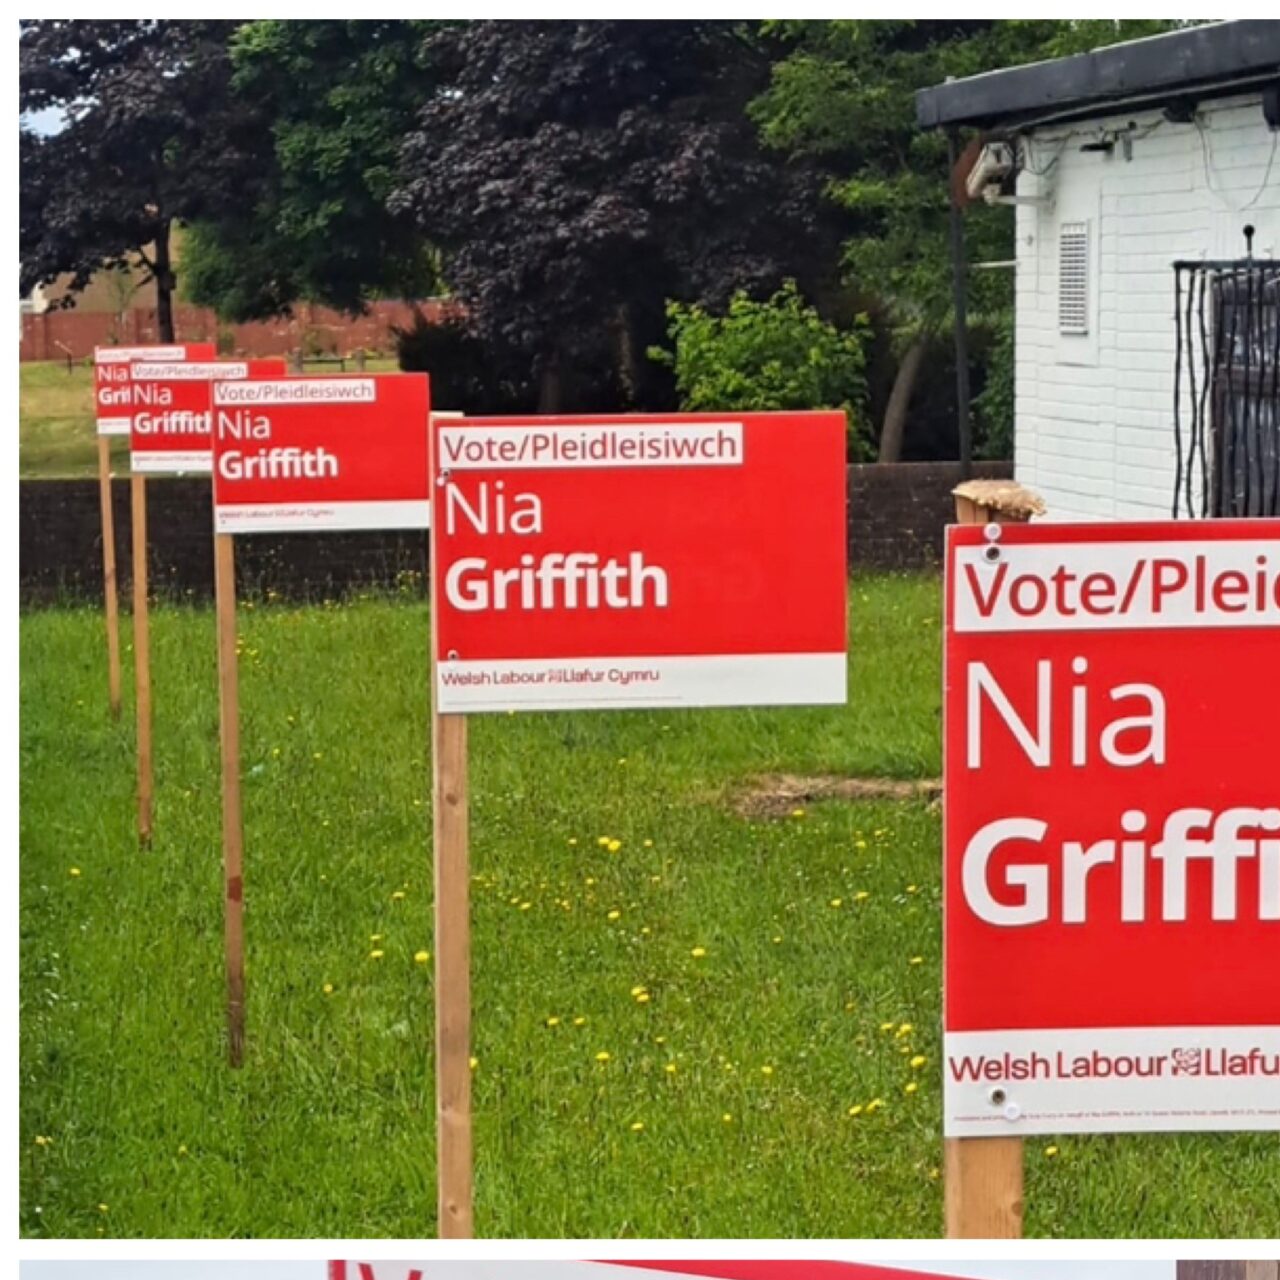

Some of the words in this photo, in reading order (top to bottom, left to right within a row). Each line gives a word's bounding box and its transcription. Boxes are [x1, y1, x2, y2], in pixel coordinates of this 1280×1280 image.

[98, 365, 129, 381] Nia
[133, 383, 173, 405] Nia
[216, 381, 373, 402] Vote/Pleidleisiwch
[218, 409, 271, 440] Nia
[443, 429, 738, 463] Vote/Pleidleisiwch
[219, 447, 339, 480] Griffith
[445, 480, 543, 536] Nia
[444, 551, 669, 612] Griffith
[442, 671, 491, 687] Welsh
[493, 669, 546, 686] Labour
[563, 668, 605, 684] Llafur
[608, 668, 660, 686] Cymru
[966, 655, 1167, 769] Nia
[949, 1051, 1051, 1083] Welsh
[1057, 1048, 1168, 1080] Labour
